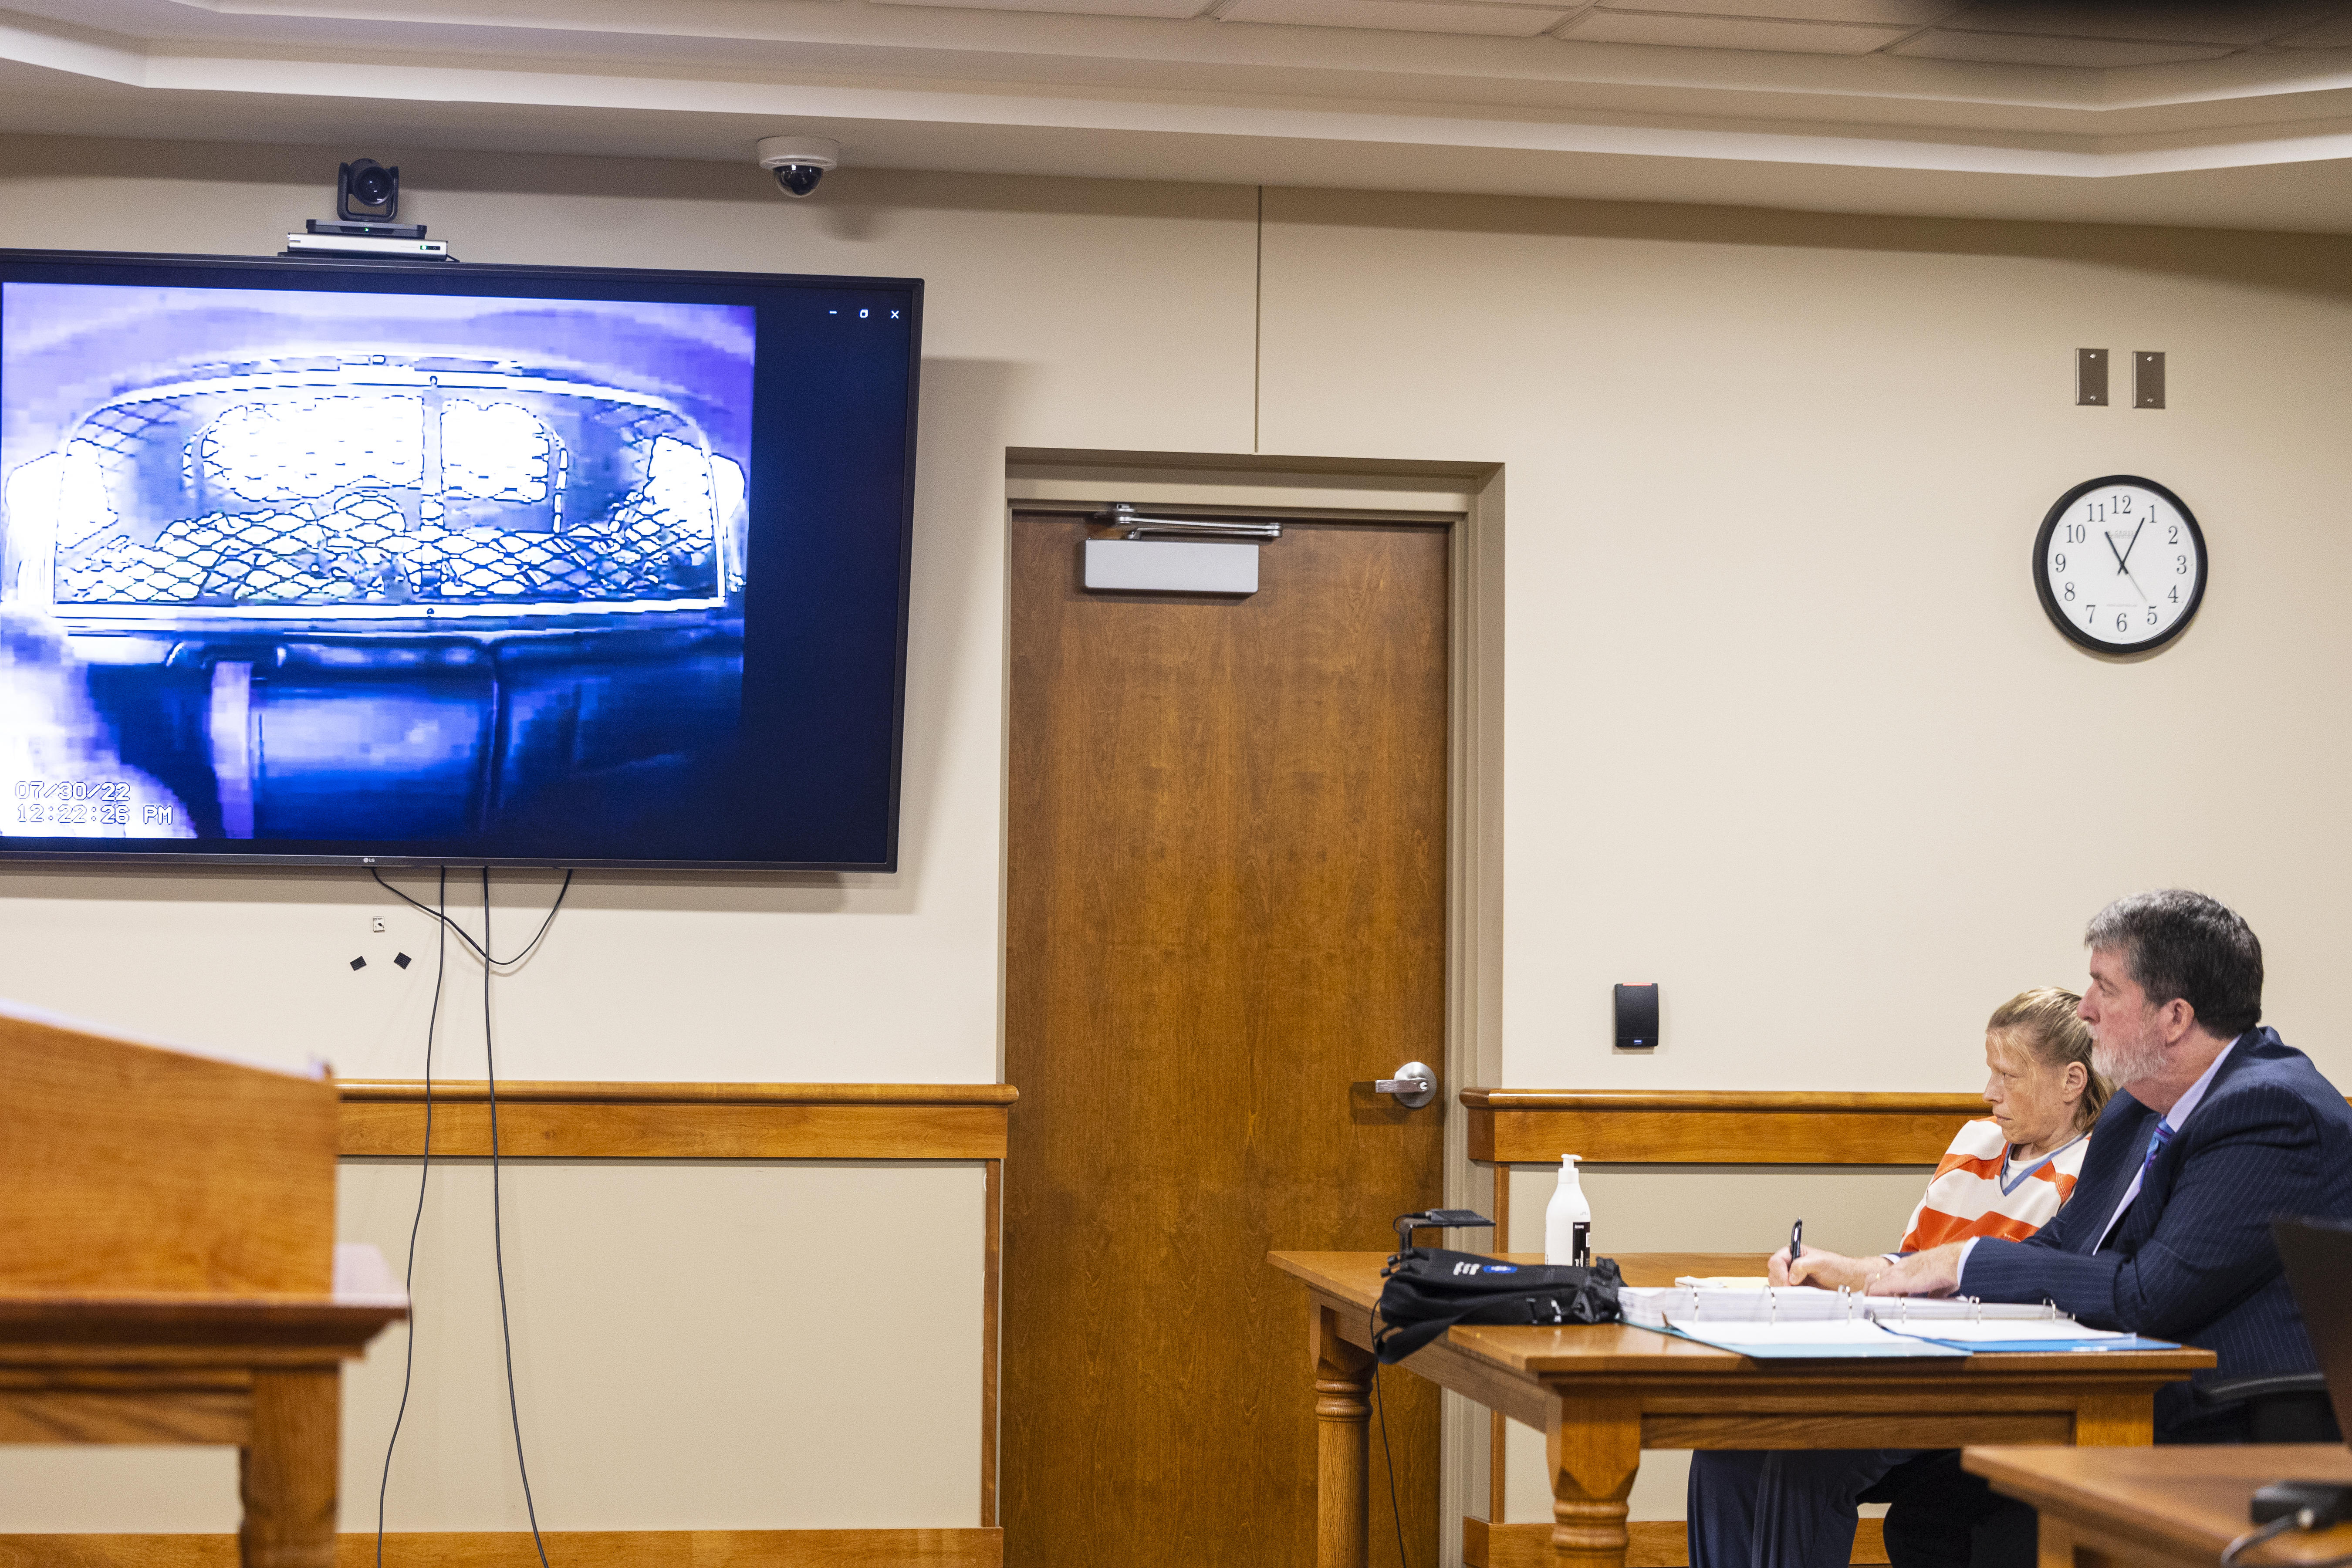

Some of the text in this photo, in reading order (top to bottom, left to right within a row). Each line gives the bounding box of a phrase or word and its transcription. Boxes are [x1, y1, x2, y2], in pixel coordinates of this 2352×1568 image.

[2087, 503, 2106, 522] 11
[2112, 495, 2131, 514] 12
[2149, 504, 2157, 524] 1
[2066, 524, 2085, 544] 10
[2168, 525, 2178, 545] 2
[2055, 553, 2066, 573] 9
[2176, 555, 2187, 574] 3
[2064, 582, 2075, 602] 8
[2167, 585, 2179, 604] 4
[2085, 605, 2096, 624] 7
[2116, 613, 2127, 632] 6
[2147, 605, 2158, 625] 5
[15, 781, 130, 801] 07/30/22
[17, 803, 173, 825] 12:22:26 PM
